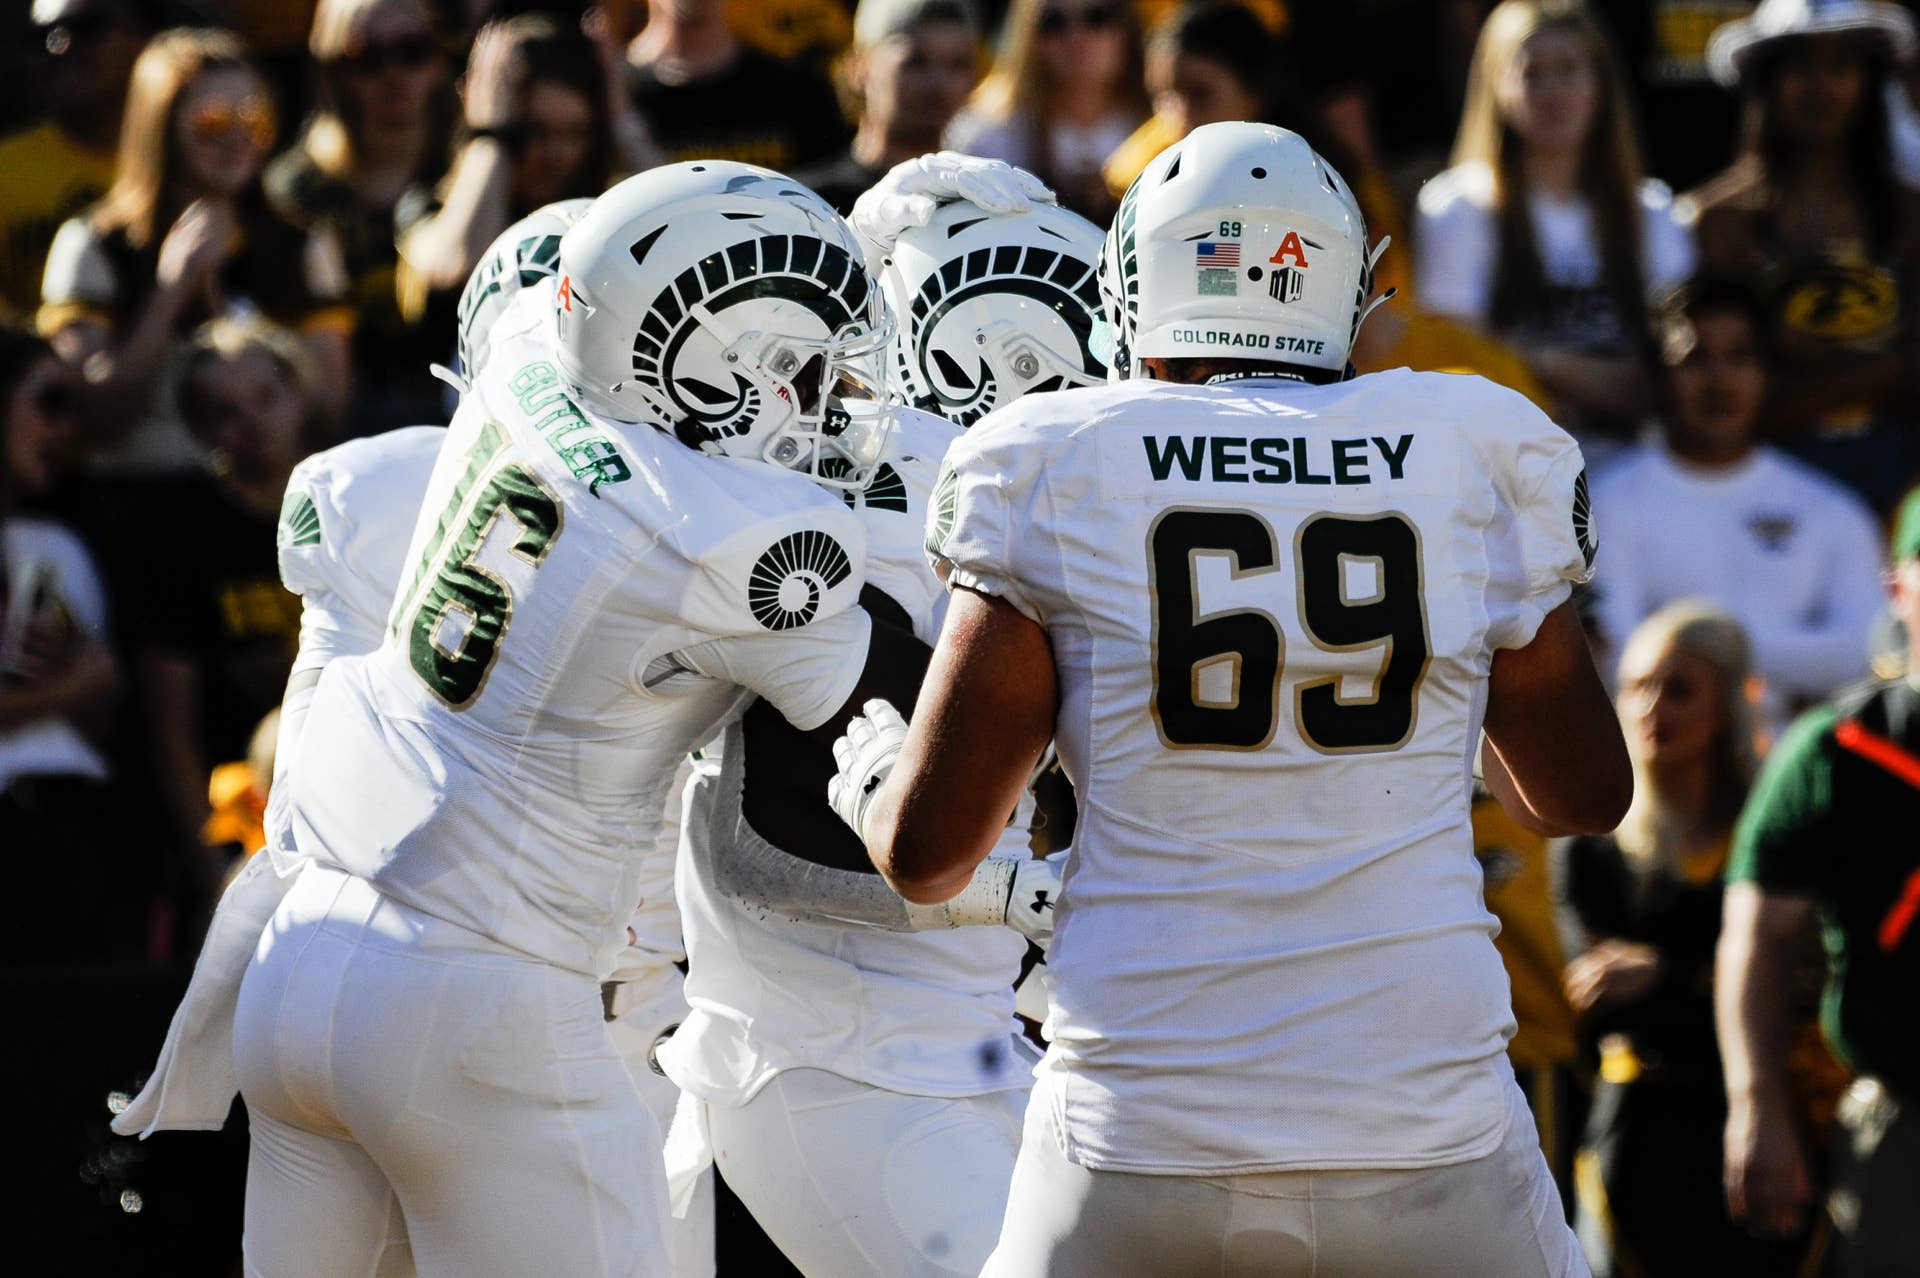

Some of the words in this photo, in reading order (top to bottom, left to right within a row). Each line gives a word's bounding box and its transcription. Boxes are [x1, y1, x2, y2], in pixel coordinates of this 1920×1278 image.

[1220, 221, 1241, 238] 69
[1269, 232, 1309, 269] A
[1173, 329, 1270, 349] COLORADO
[1275, 335, 1325, 356] STATE
[508, 360, 632, 499] BUTLER
[1142, 434, 1415, 486] WESLEY
[389, 418, 565, 712] 16
[1145, 505, 1434, 756] 69
